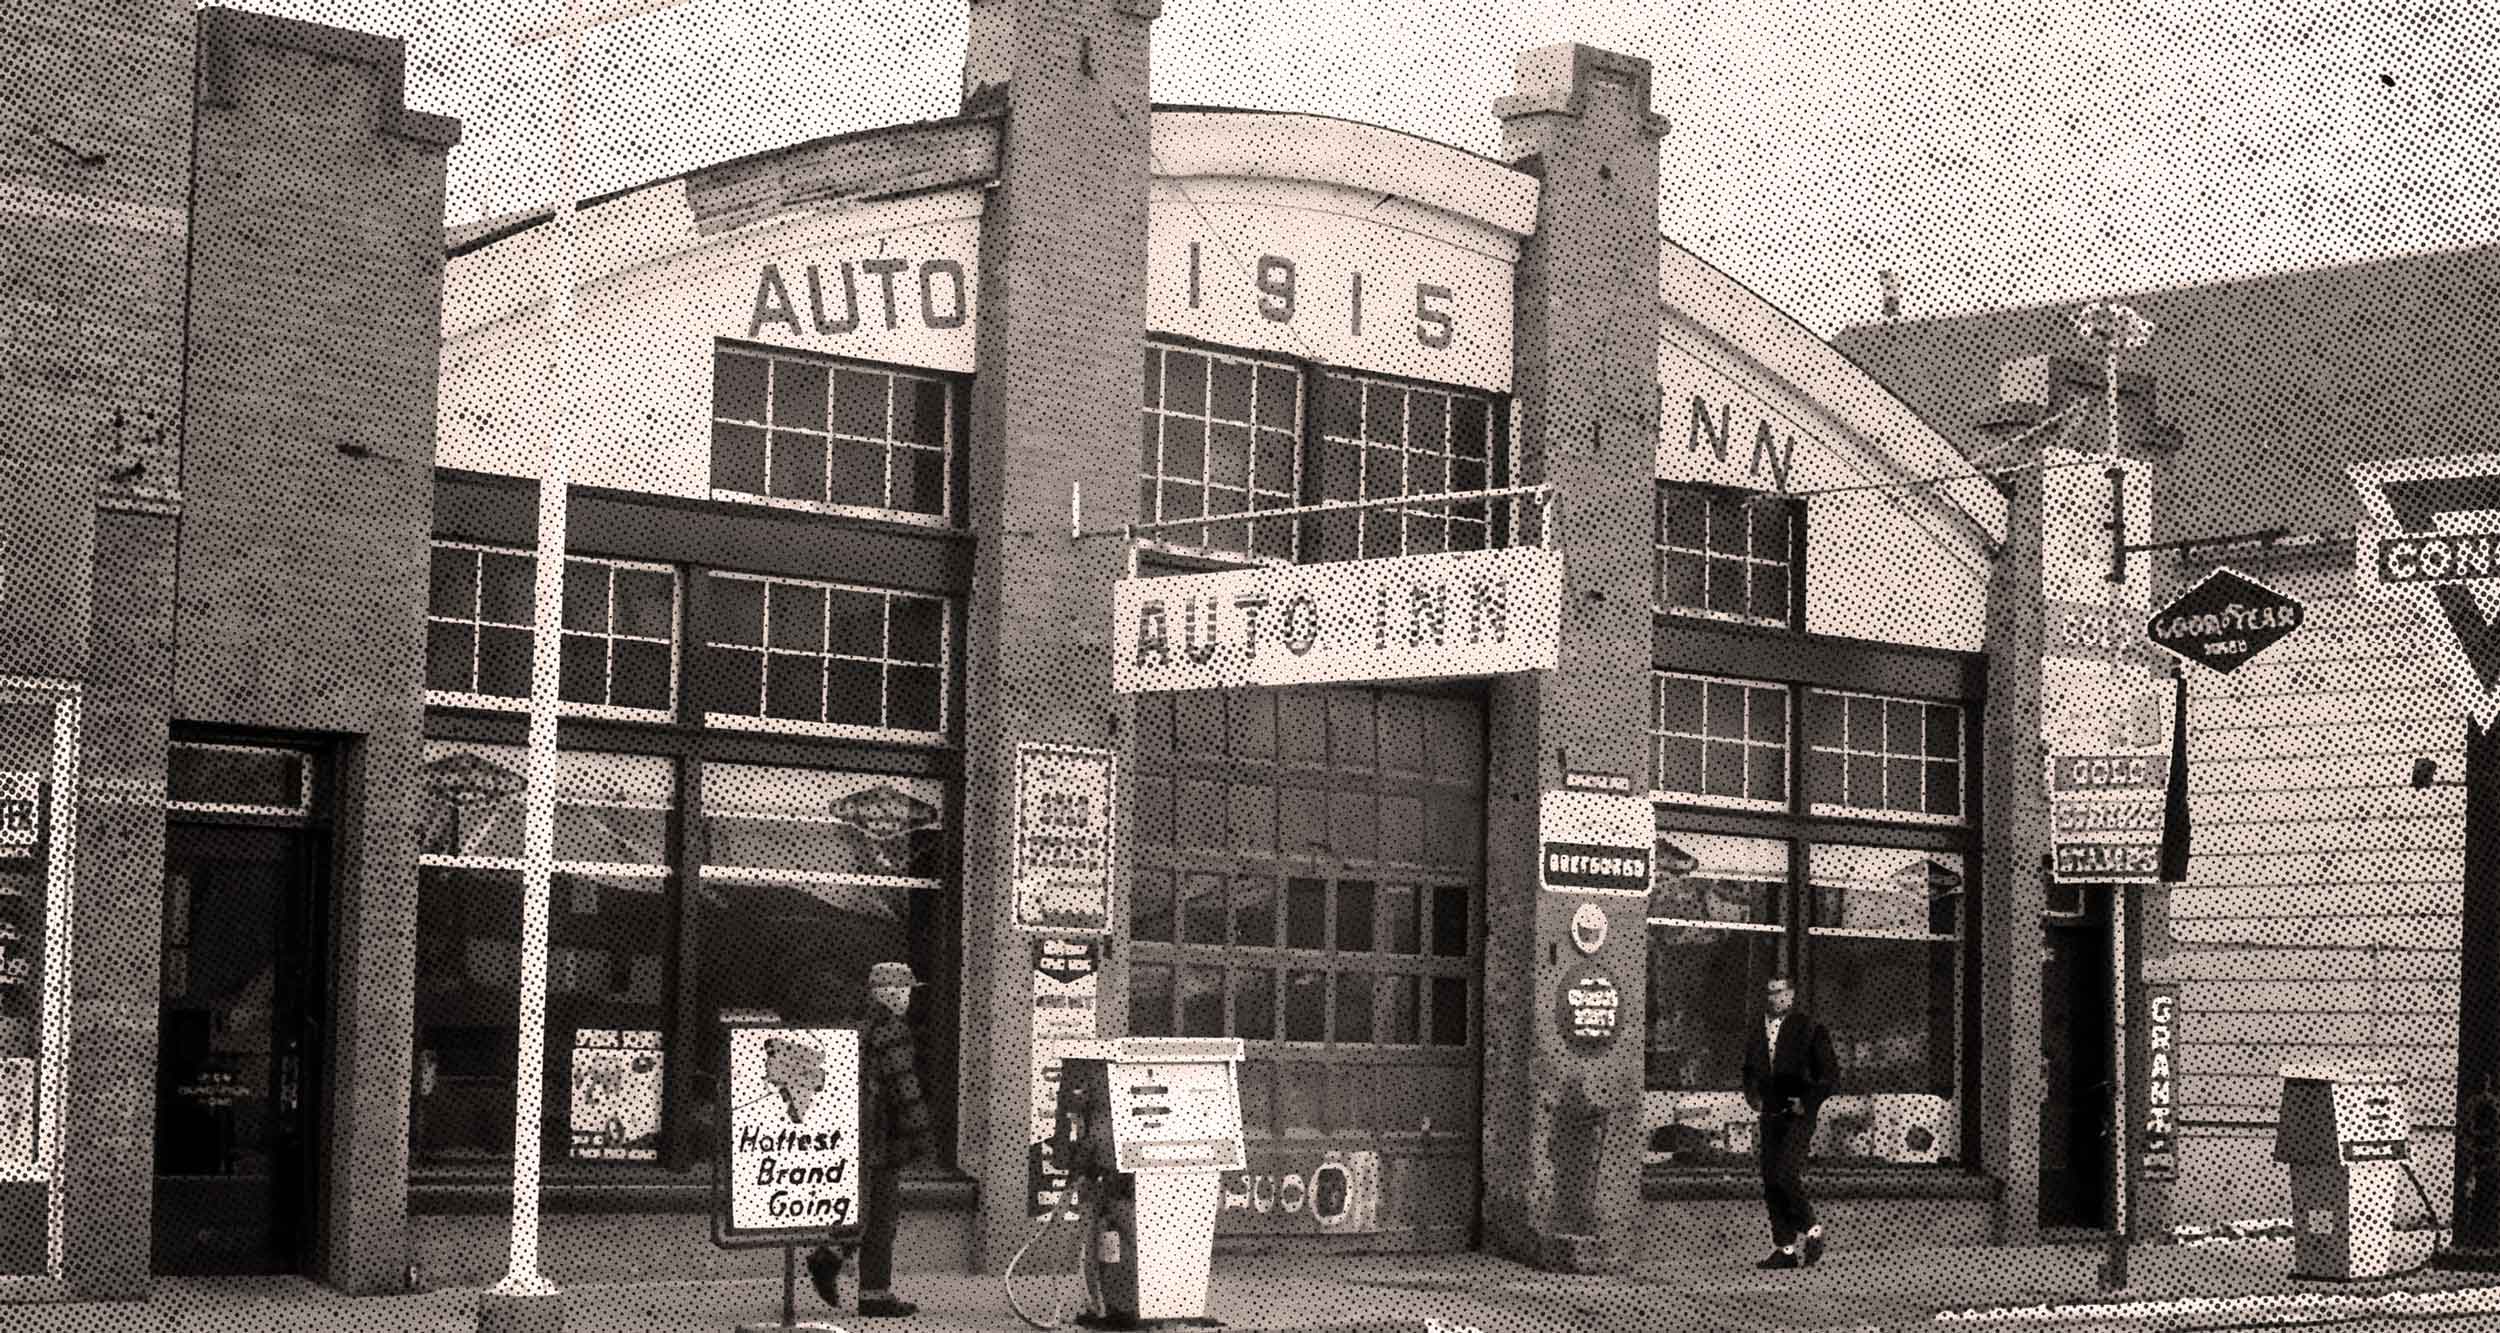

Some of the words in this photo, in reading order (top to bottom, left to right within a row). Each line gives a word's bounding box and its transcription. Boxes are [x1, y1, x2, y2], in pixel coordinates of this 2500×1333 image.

[748, 257, 967, 338] AUTO
[1188, 241, 1453, 350] 1915
[2386, 537, 2500, 580] CON
[1136, 594, 1319, 670] AUTO
[1374, 575, 1507, 651] INN
[2154, 602, 2296, 640] GOODYEAR
[2072, 758, 2147, 785] GOLD
[738, 1125, 842, 1153] Hottest
[756, 1156, 847, 1186] Brand
[768, 1189, 851, 1228] Going
